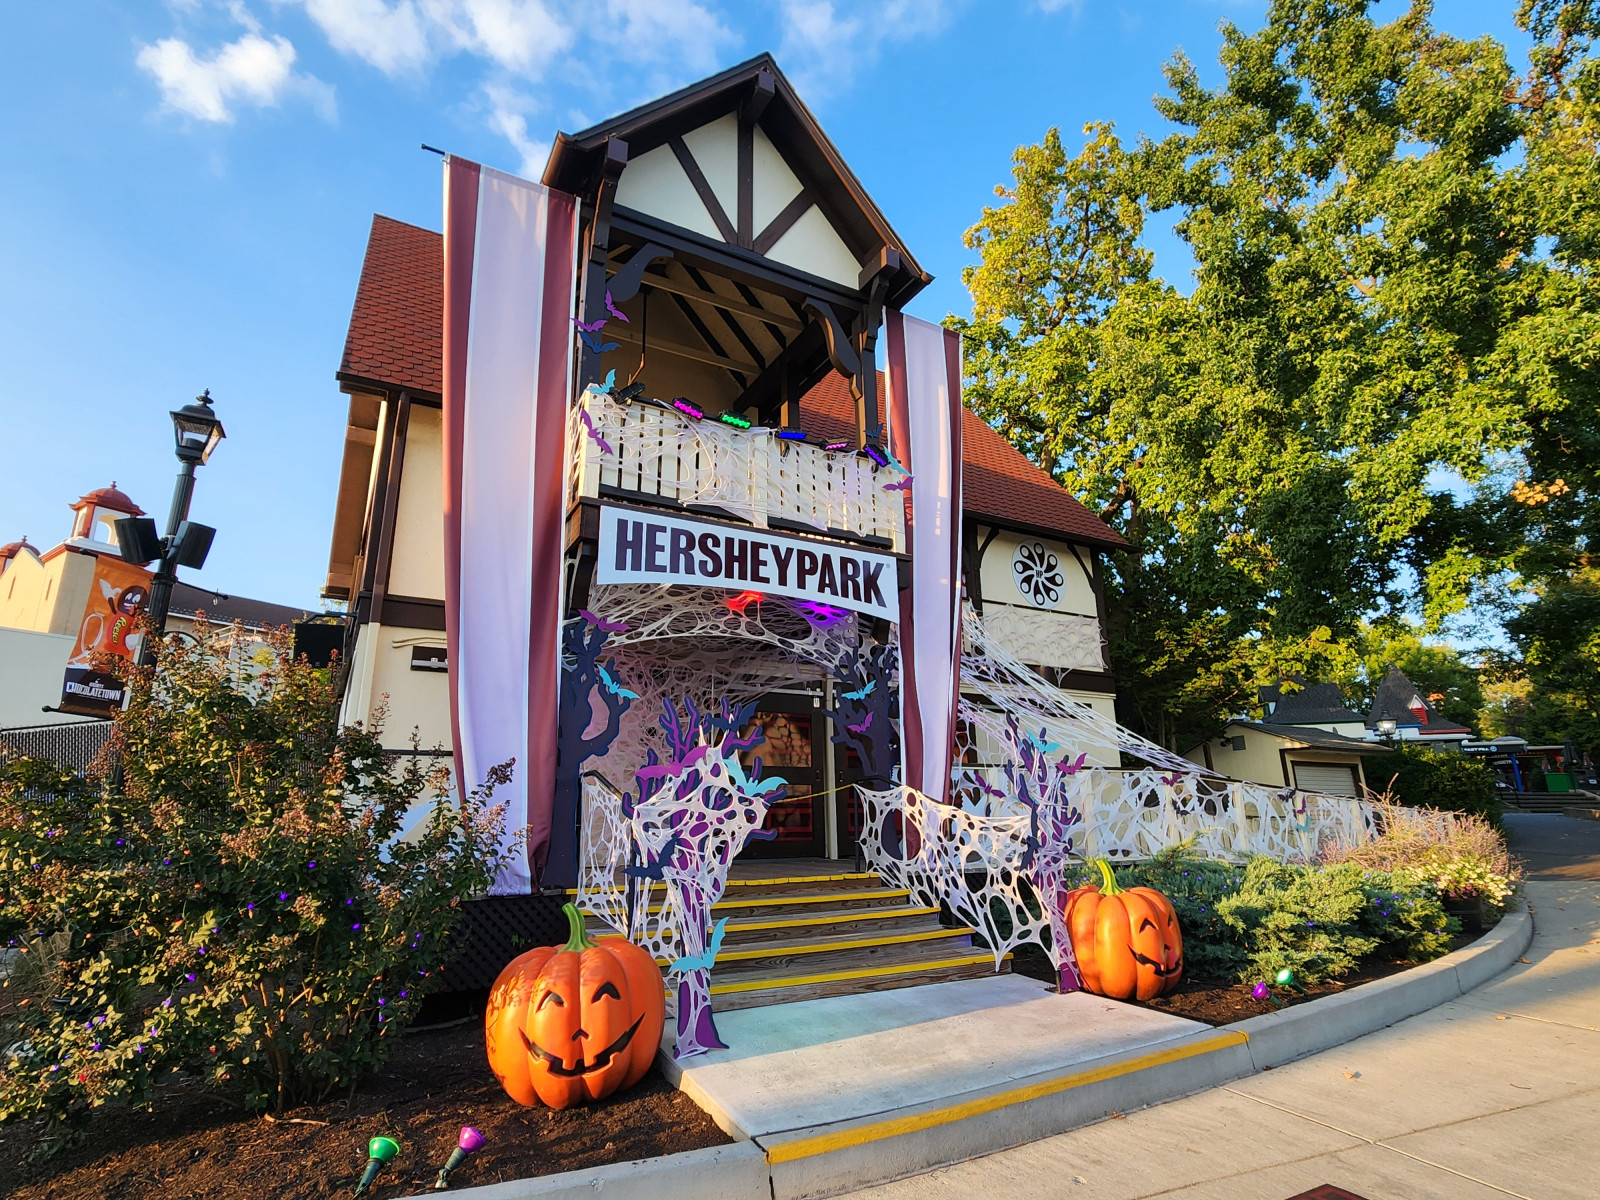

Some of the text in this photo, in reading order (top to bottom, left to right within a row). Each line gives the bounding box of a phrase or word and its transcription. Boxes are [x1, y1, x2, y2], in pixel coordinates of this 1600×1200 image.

[615, 518, 887, 608] HERSHEYPARK
[1035, 569, 1044, 579] HP
[66, 681, 121, 701] CHOCOLATETOWN
